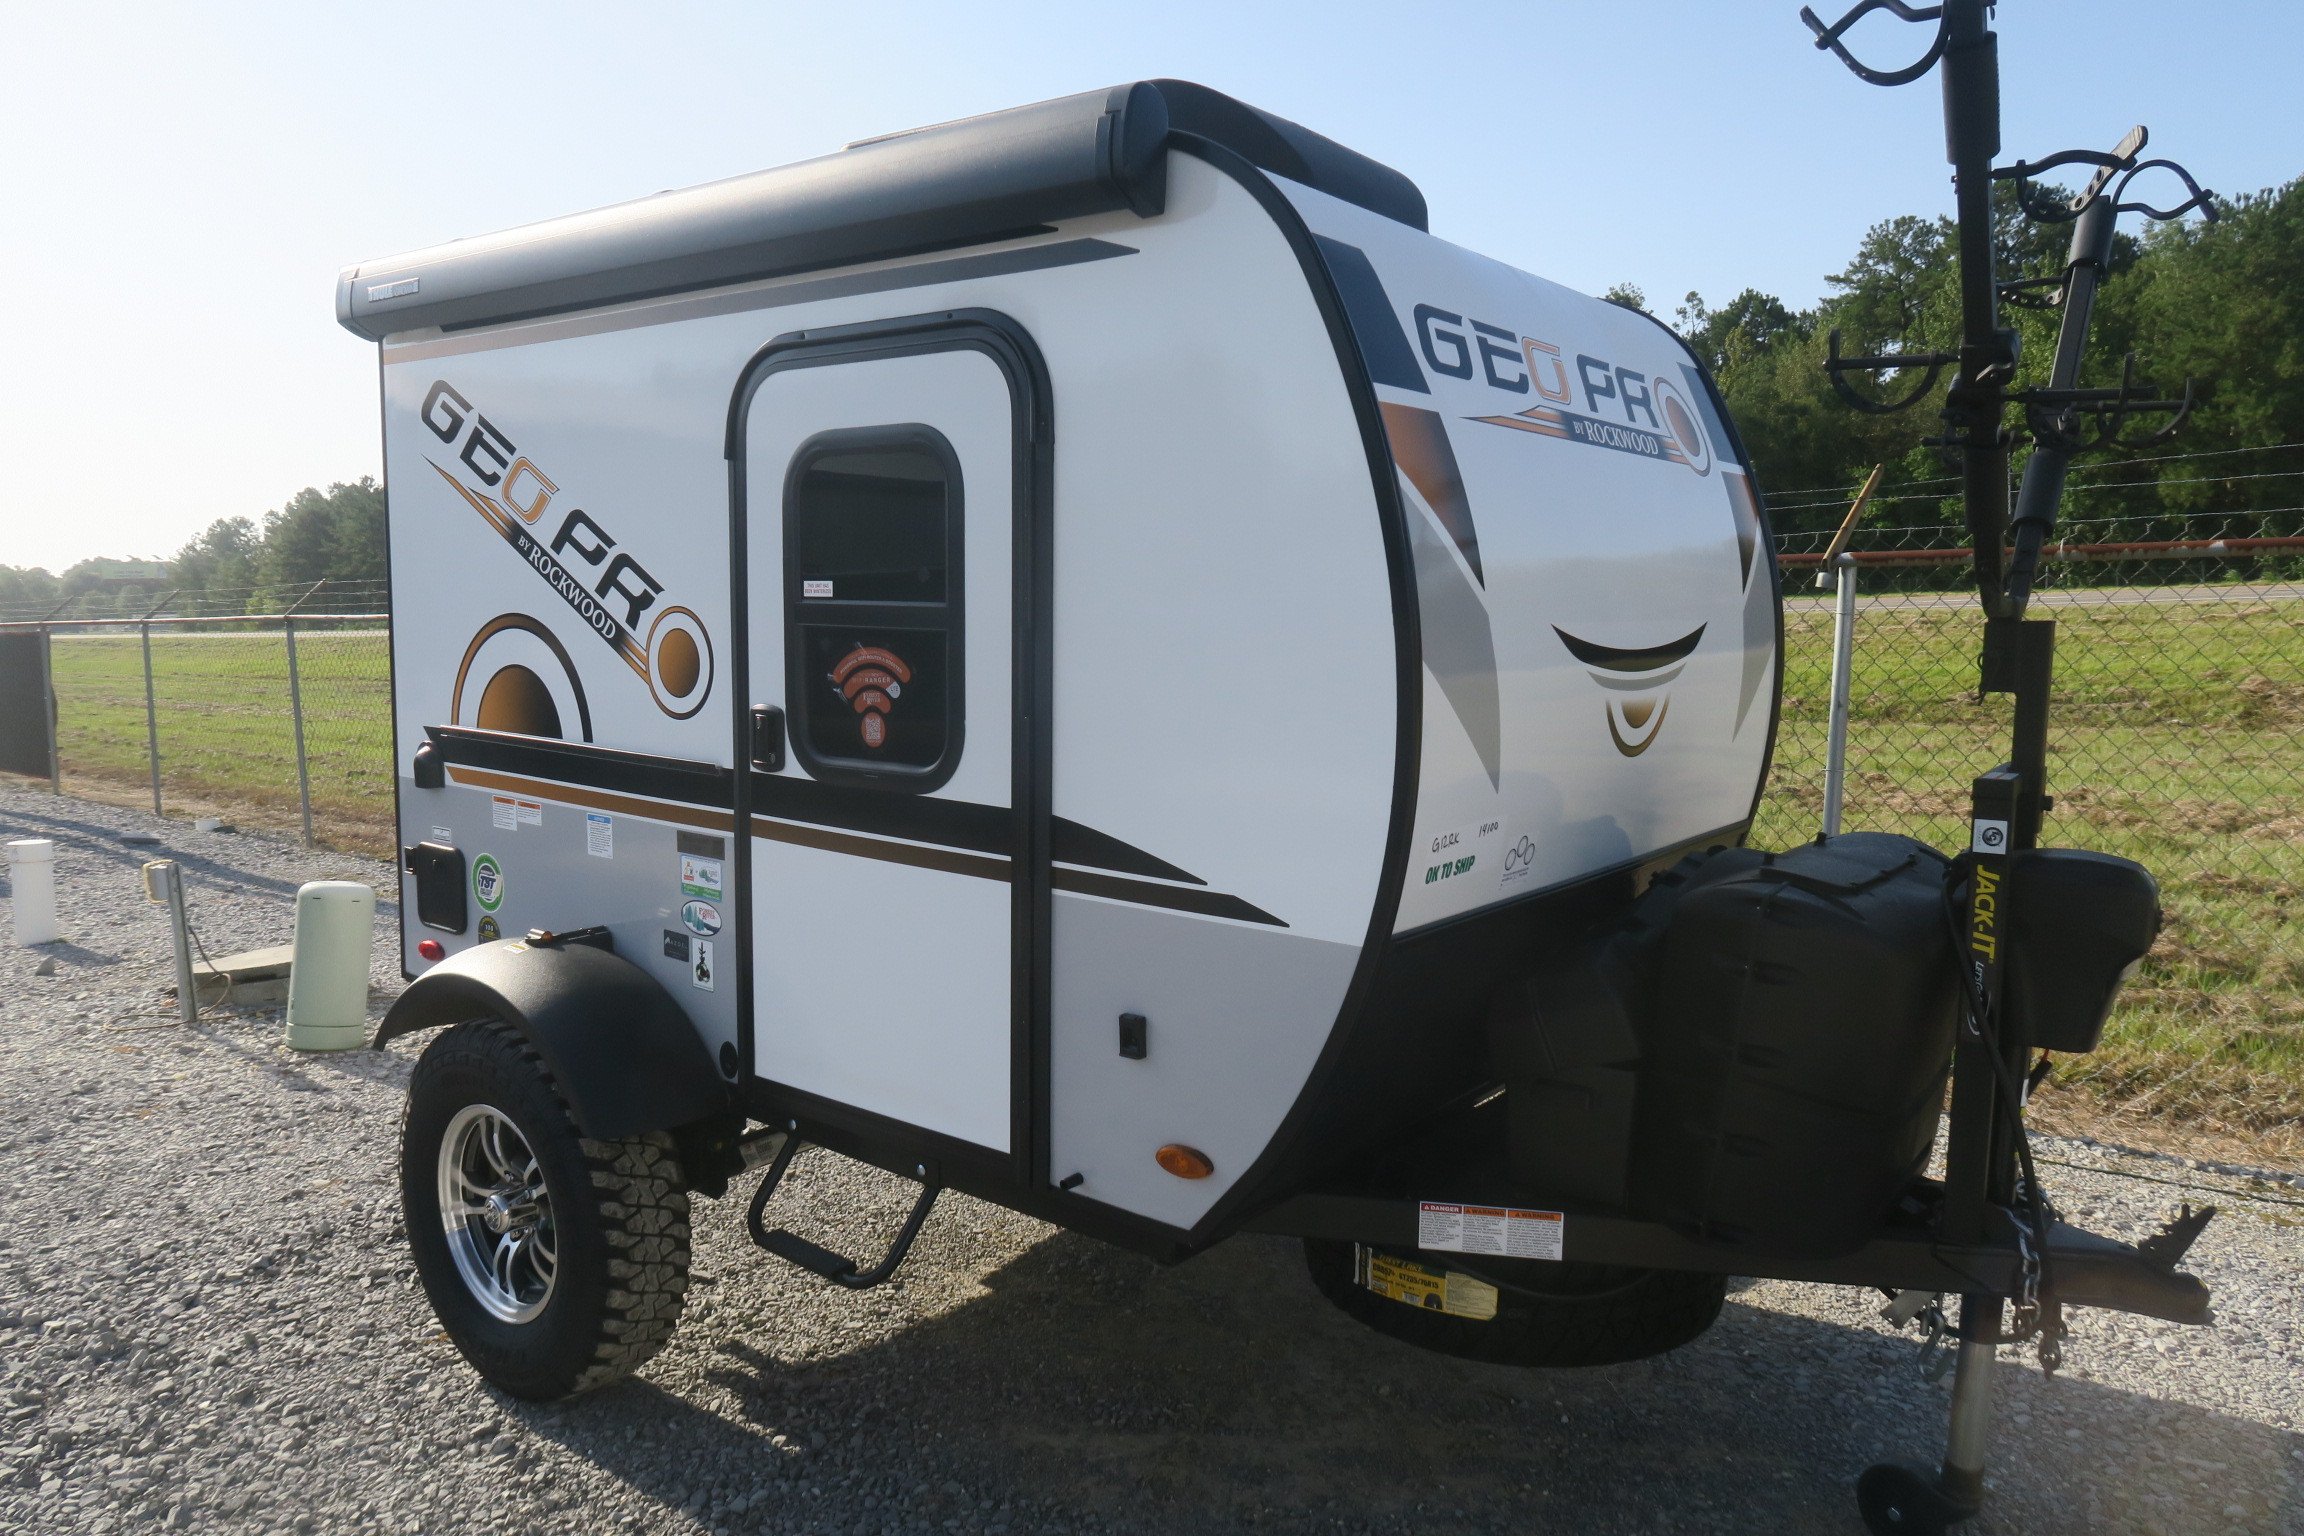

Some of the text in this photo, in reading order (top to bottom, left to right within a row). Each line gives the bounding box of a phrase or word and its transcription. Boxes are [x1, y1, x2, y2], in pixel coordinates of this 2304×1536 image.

[1413, 303, 1712, 477] GEO PRO
[1574, 420, 1659, 455] BY ROCKWOOD
[420, 379, 715, 721] GEO PRO
[517, 534, 617, 641] BY ROCKWOOD
[1425, 855, 1476, 884] OK TO SHIP
[1971, 864, 2001, 961] JACK-IT
[1430, 1205, 1459, 1213] DANGER
[1471, 1208, 1505, 1217] WARNING
[1522, 1212, 1555, 1220] WARNING
